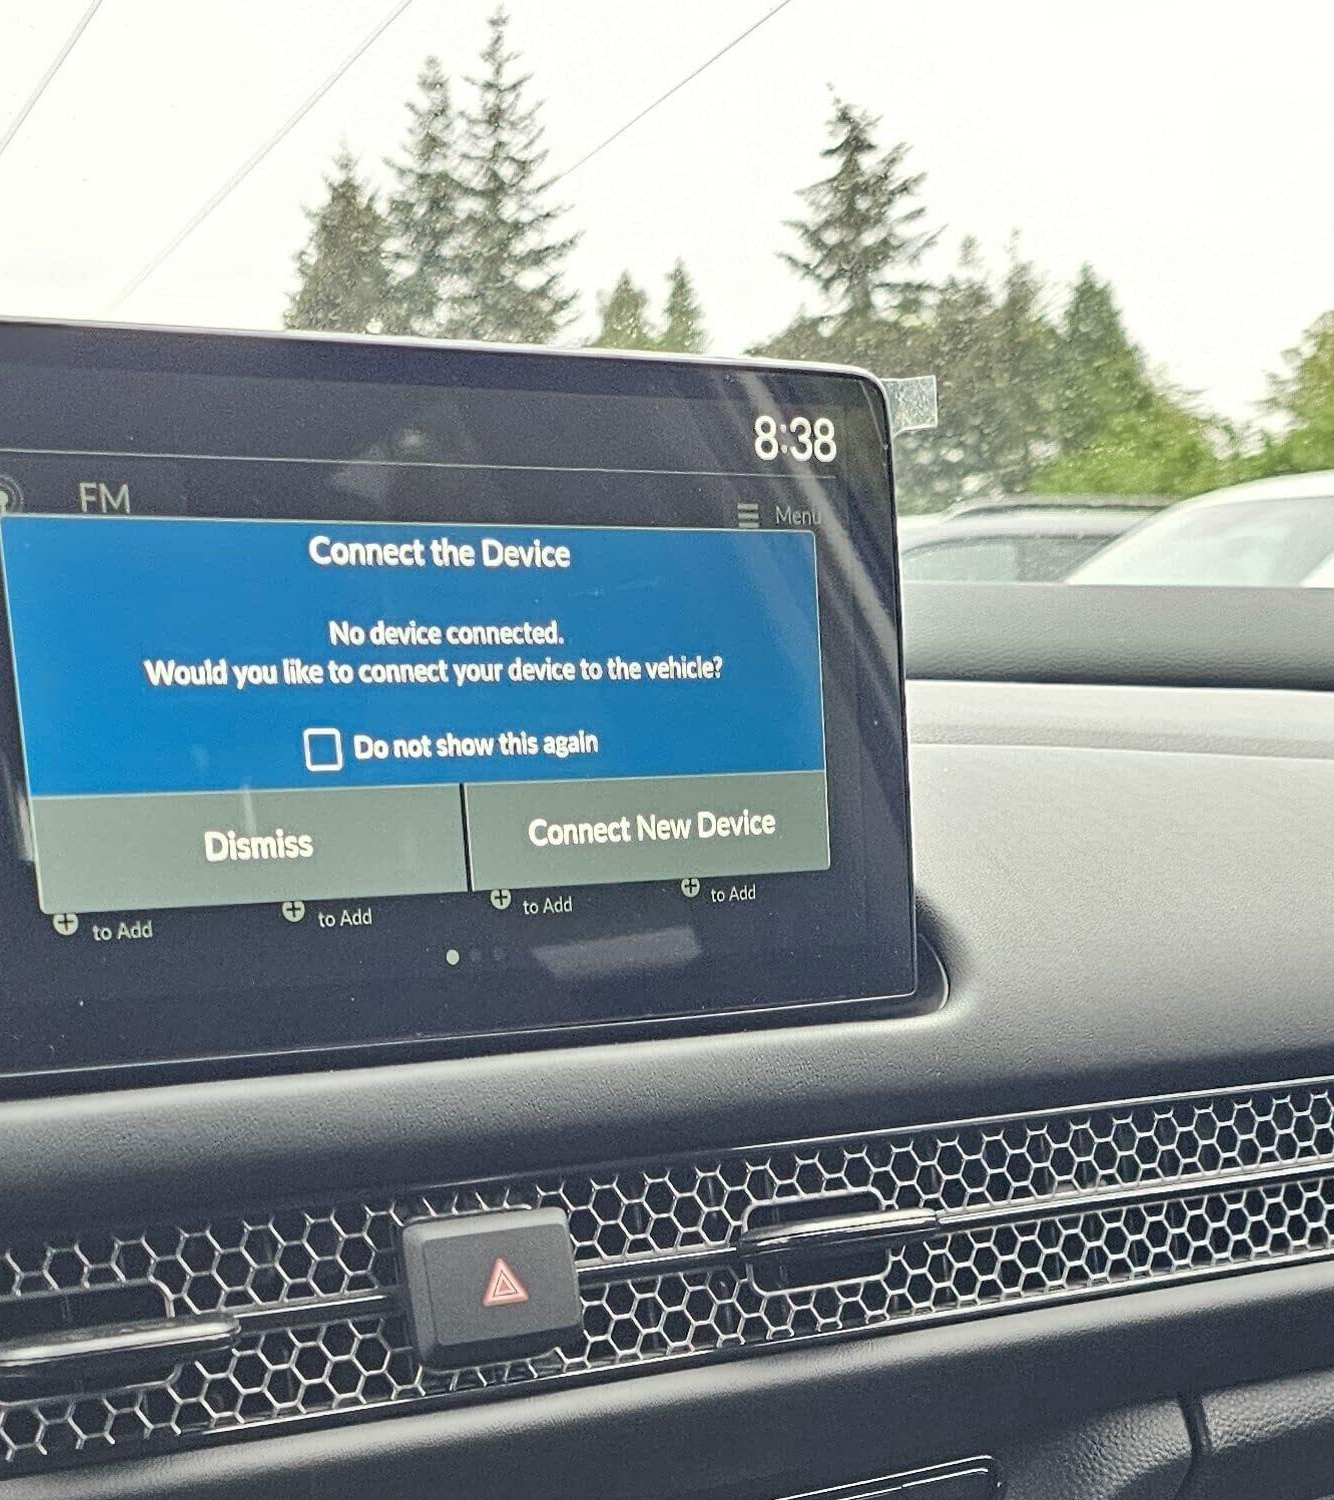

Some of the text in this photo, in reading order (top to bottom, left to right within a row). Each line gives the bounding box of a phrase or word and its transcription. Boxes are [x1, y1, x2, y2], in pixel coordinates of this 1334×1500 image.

[754, 415, 837, 462] 8:38
[79, 482, 131, 513] FM
[776, 505, 821, 525] Menu
[309, 535, 570, 568] Connect the Device
[329, 620, 564, 646] No device connected.
[144, 655, 723, 691] Would you like to connect your device to the vehicle?
[354, 732, 599, 760] Do not show this again
[528, 809, 776, 847] Connect New Device
[204, 829, 314, 862] Dismiss
[523, 895, 573, 915] to Add
[711, 883, 757, 903] to Add
[92, 919, 153, 942] to Add
[318, 906, 373, 928] to Add
